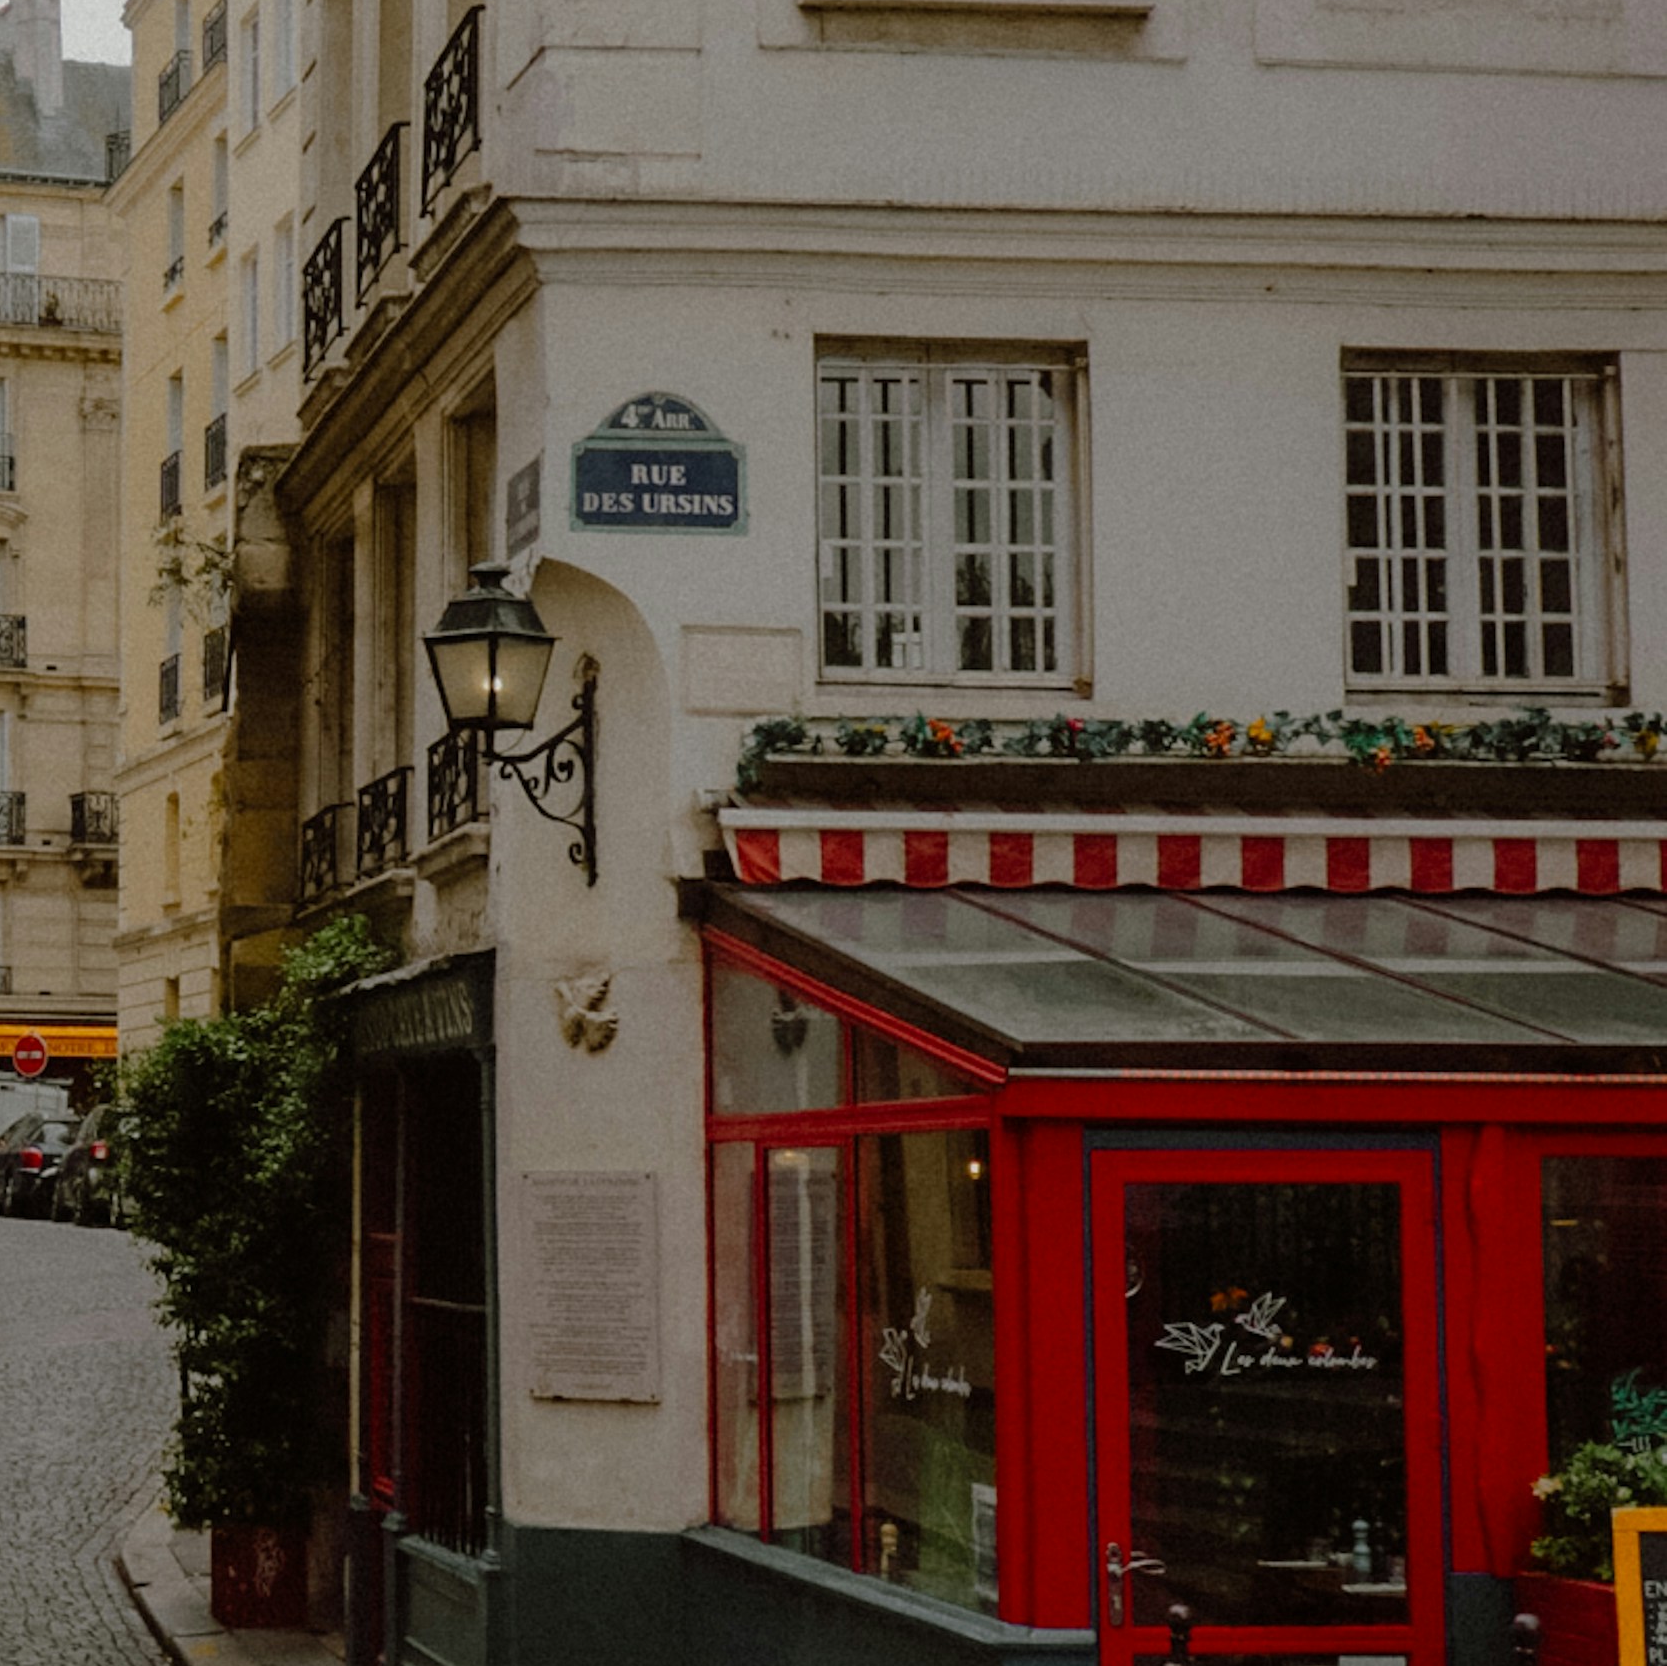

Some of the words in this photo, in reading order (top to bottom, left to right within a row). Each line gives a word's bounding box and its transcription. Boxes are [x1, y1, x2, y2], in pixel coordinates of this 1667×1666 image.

[630, 463, 687, 486] RUE
[583, 492, 635, 514] DES
[641, 493, 734, 516] URSINS
[1221, 1341, 1256, 1376] Les
